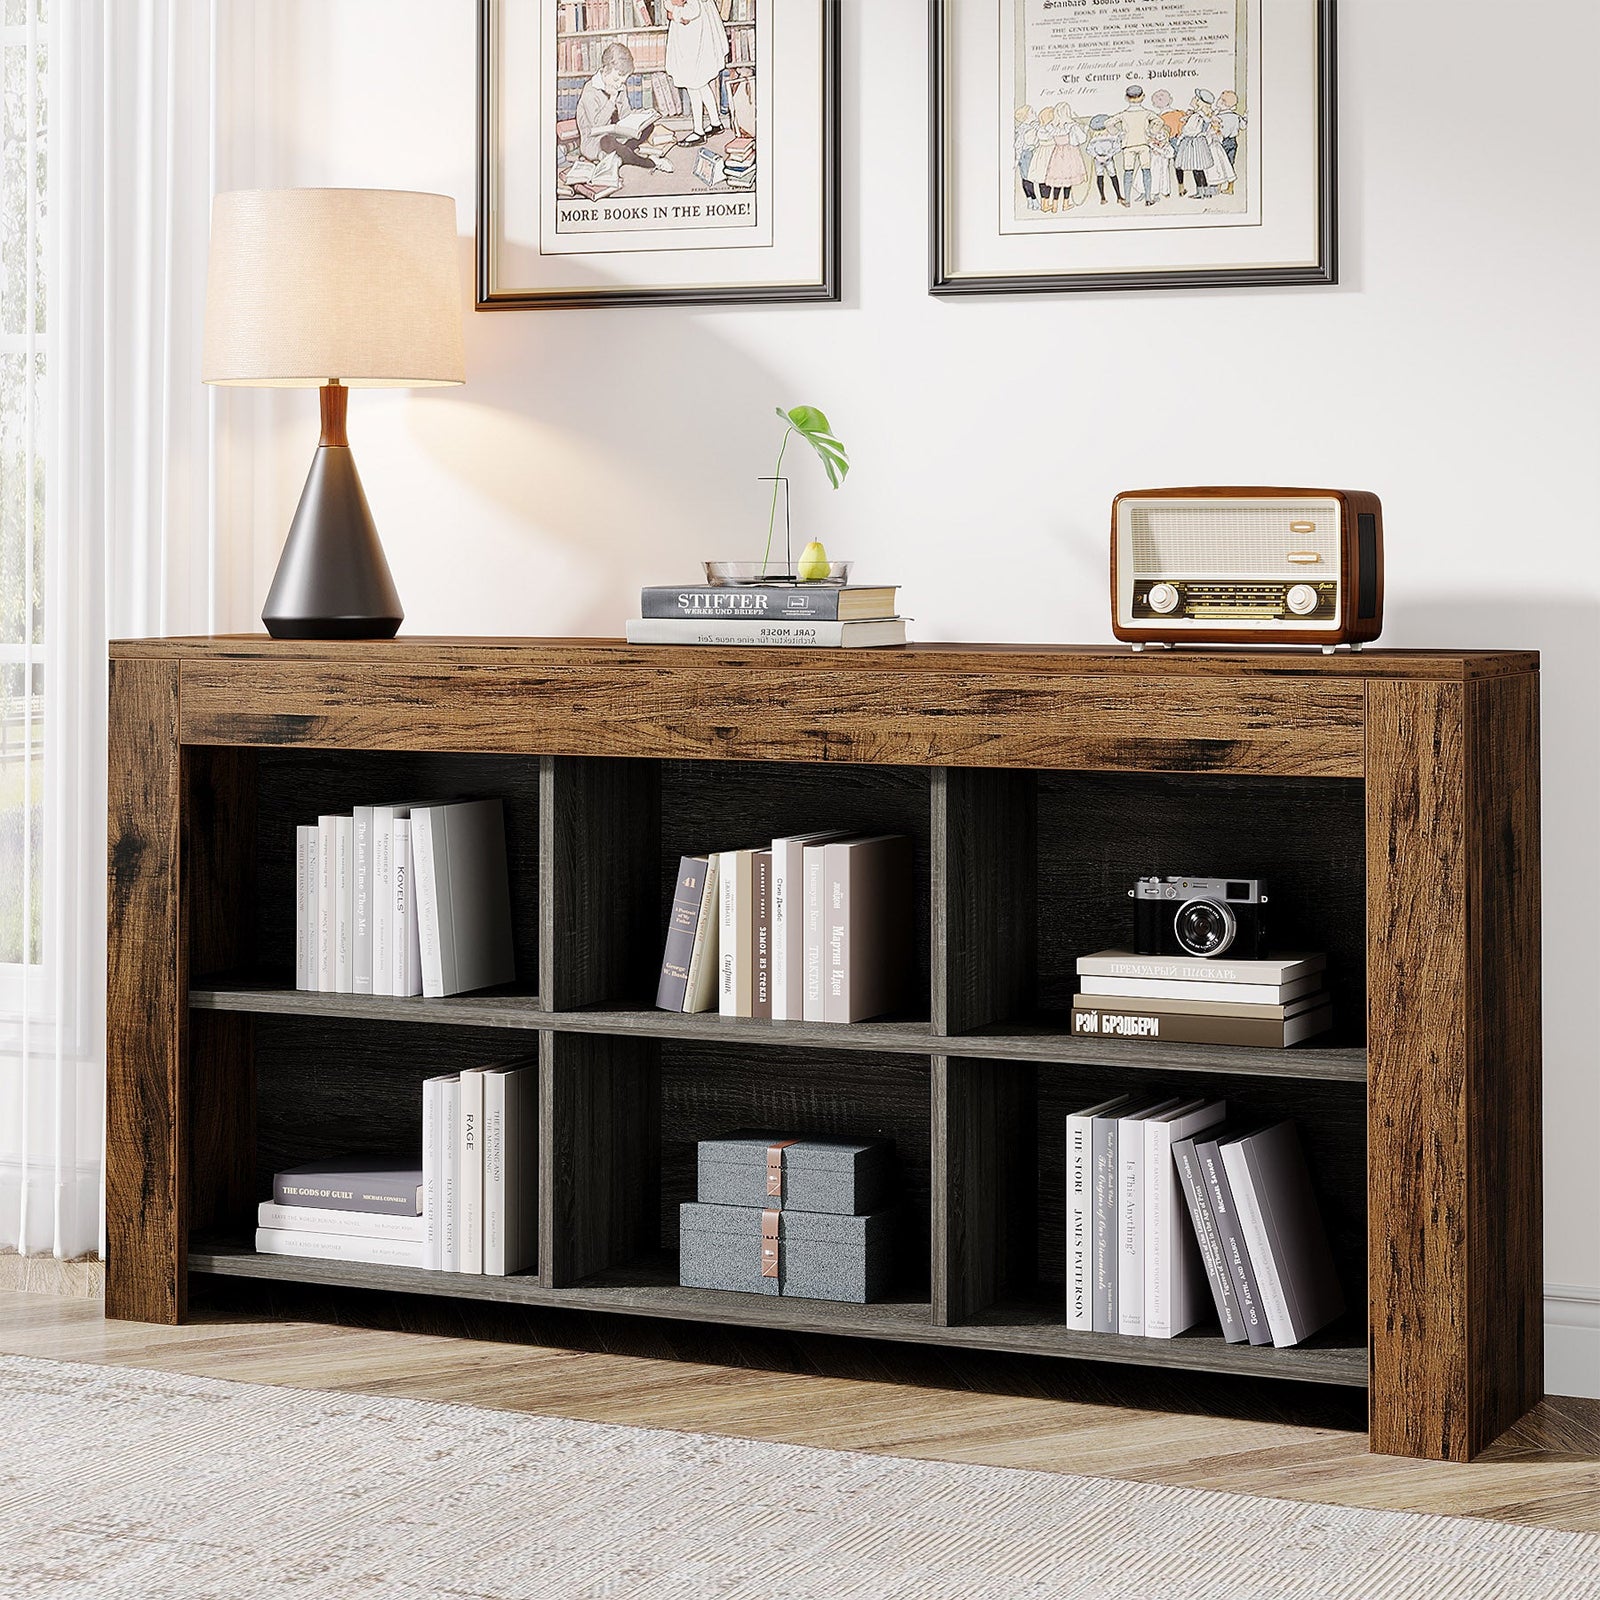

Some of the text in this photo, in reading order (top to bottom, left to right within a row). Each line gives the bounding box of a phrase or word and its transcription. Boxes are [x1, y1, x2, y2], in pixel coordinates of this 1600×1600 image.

[1061, 73, 1080, 83] The
[1085, 72, 1121, 83] Century
[560, 203, 751, 222] MORE BOOKS IN THE HOME!
[677, 593, 769, 609] STIFTER
[356, 822, 367, 936] The Last Time They Met
[682, 877, 697, 888] 41
[830, 926, 844, 966] Мартин
[1110, 963, 1177, 976] ПРЕМУДРЫЙ
[831, 969, 845, 996] Иден
[1075, 1010, 1159, 1036] РЭЙ БРЭДБЕРИ
[466, 1113, 474, 1151] RAGE
[493, 1111, 501, 1182] THE EVENING AND
[1074, 1129, 1083, 1195] THE STORE
[1181, 1154, 1192, 1178] Cochran
[282, 1186, 353, 1199] THE GODS OF GUILT
[1194, 1184, 1203, 1200] Print
[1126, 1161, 1136, 1255] Is This Anything?
[1192, 1207, 1204, 1232] Literary
[1201, 1208, 1210, 1221] Age
[1096, 1154, 1107, 1290] The Origins of Our Discontents
[1074, 1208, 1084, 1319] JAMES PATTERSON
[1204, 1252, 1216, 1276] Twilight
[1209, 1239, 1222, 1265] Thought
[1218, 1272, 1230, 1295] Figures
[1224, 1306, 1234, 1323] Terry
